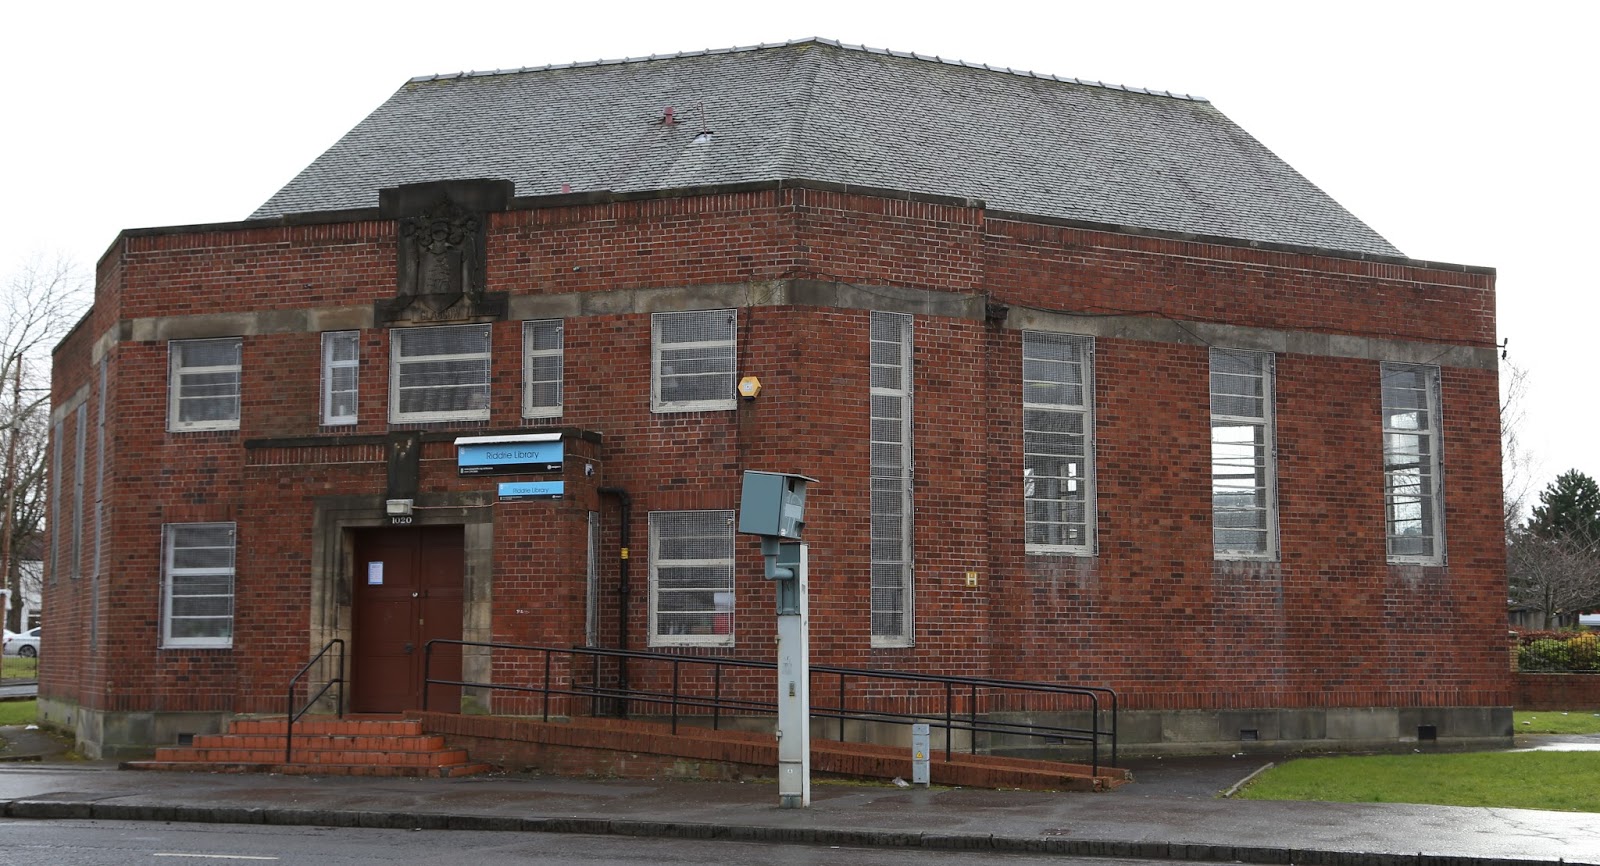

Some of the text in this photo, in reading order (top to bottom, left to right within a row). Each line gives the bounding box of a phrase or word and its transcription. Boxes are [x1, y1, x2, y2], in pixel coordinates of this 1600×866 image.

[486, 450, 539, 460] Riddrie Library
[532, 486, 549, 494] Library
[968, 572, 976, 585] H
